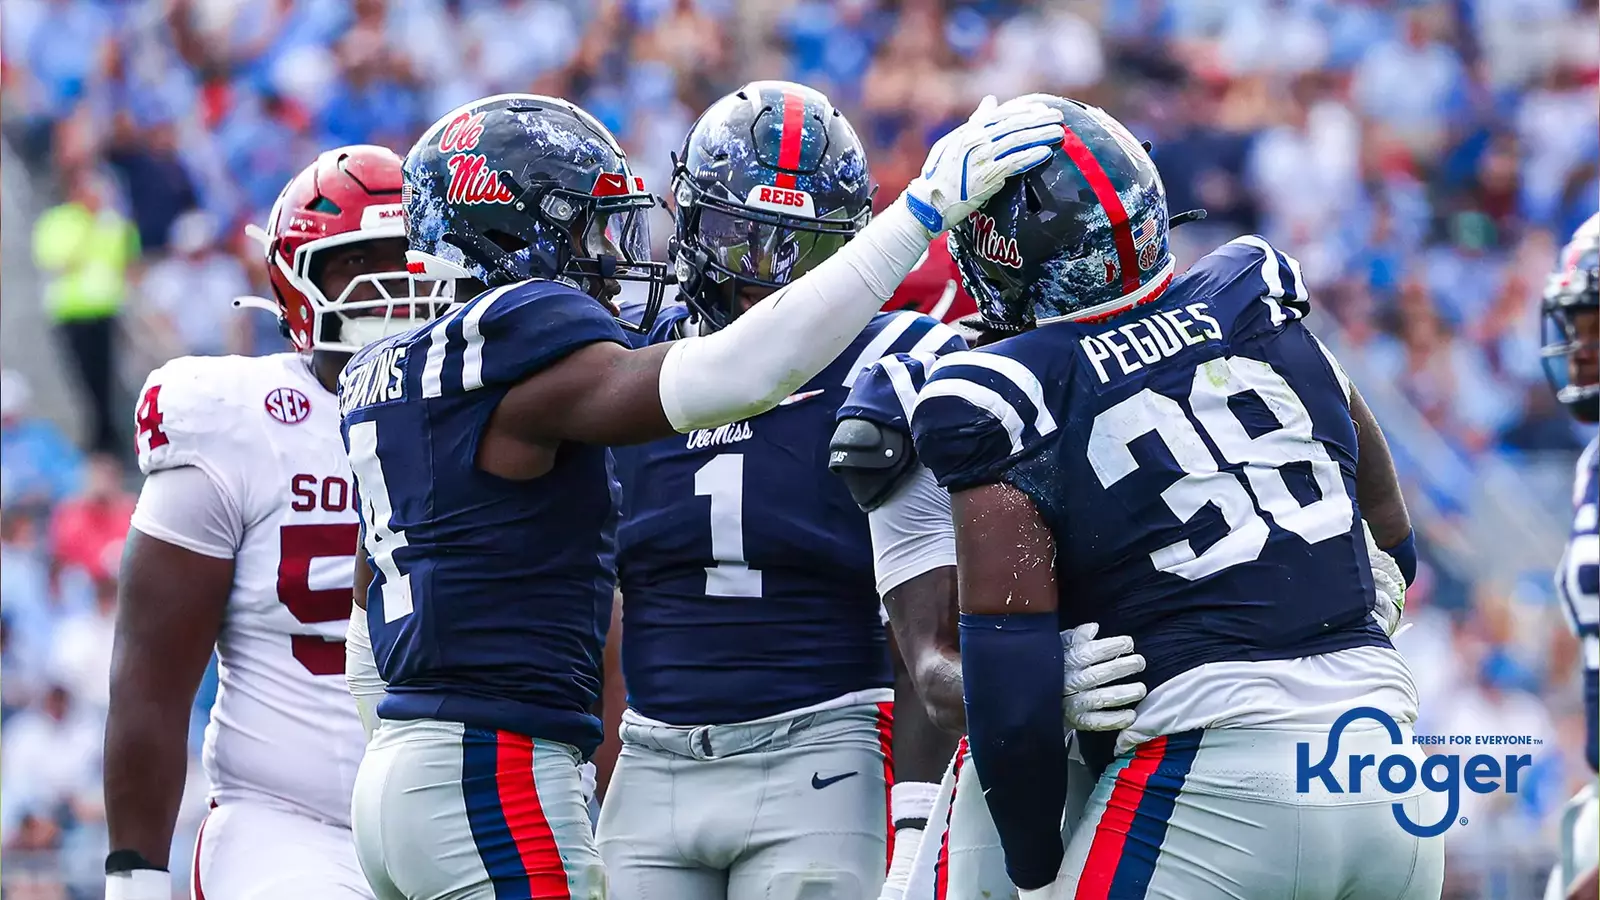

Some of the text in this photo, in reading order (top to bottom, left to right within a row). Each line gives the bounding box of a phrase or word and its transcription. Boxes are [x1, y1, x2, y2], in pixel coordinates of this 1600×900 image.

[439, 112, 484, 152] Ole
[447, 153, 515, 205] Miss
[759, 187, 805, 207] REBS
[968, 210, 1023, 268] Miss
[1079, 302, 1223, 384] PEGUES
[134, 385, 170, 455] 4
[266, 388, 311, 424] SEC
[291, 474, 358, 512] SO
[1086, 355, 1354, 581] 38
[349, 420, 414, 624] 4
[694, 453, 762, 598] 1
